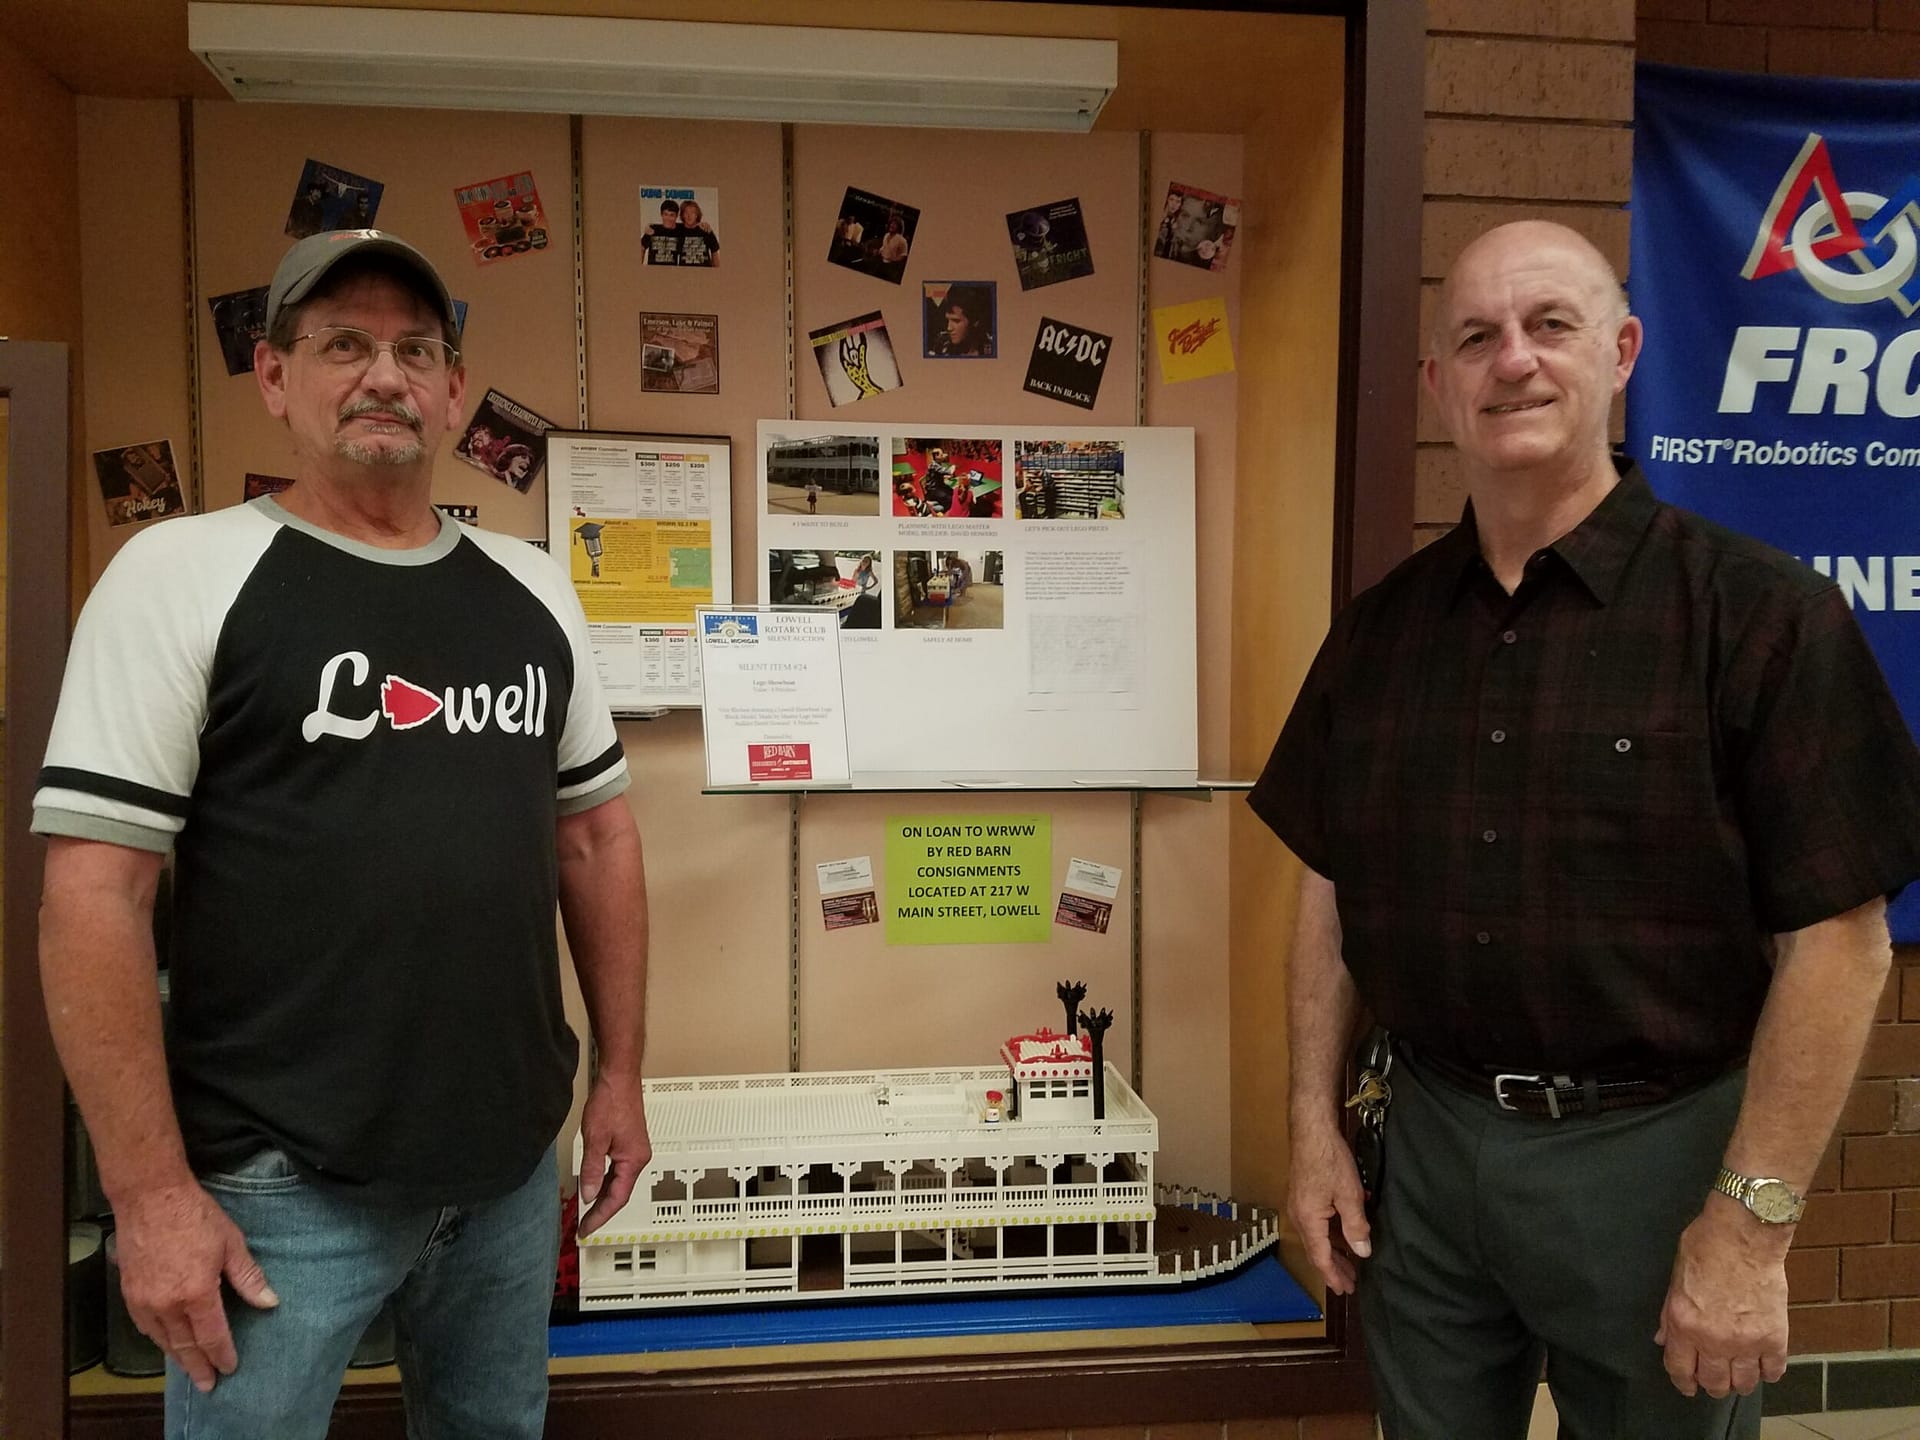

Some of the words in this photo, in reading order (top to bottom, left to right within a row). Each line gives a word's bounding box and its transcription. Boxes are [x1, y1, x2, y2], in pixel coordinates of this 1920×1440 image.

[1030, 378, 1053, 391] BACK
[1053, 385, 1063, 394] IN
[1063, 388, 1091, 403] BLACK
[1732, 439, 1858, 465] Robotics
[776, 616, 812, 624] LOWELL
[765, 626, 801, 634] ROTARY
[803, 626, 826, 634] CLUB
[738, 663, 768, 672] SILENT
[769, 663, 792, 672] ITEM
[763, 745, 777, 759] RED
[778, 744, 796, 758] BARN
[902, 827, 922, 838] ON
[926, 826, 961, 837] LOAN
[965, 825, 983, 837] TO
[987, 825, 1036, 836] WRWW
[927, 847, 943, 857] BY
[947, 846, 972, 857] RED
[976, 845, 1011, 857] BARN
[917, 865, 1021, 878] CONSIGNMENTS
[908, 886, 966, 898] LOCATED
[970, 886, 987, 897] AT
[990, 885, 1013, 897] 217
[1016, 885, 1030, 896] W
[898, 906, 934, 918] MAIN
[937, 905, 987, 918] STREET,
[990, 905, 1040, 917] LOWELL
